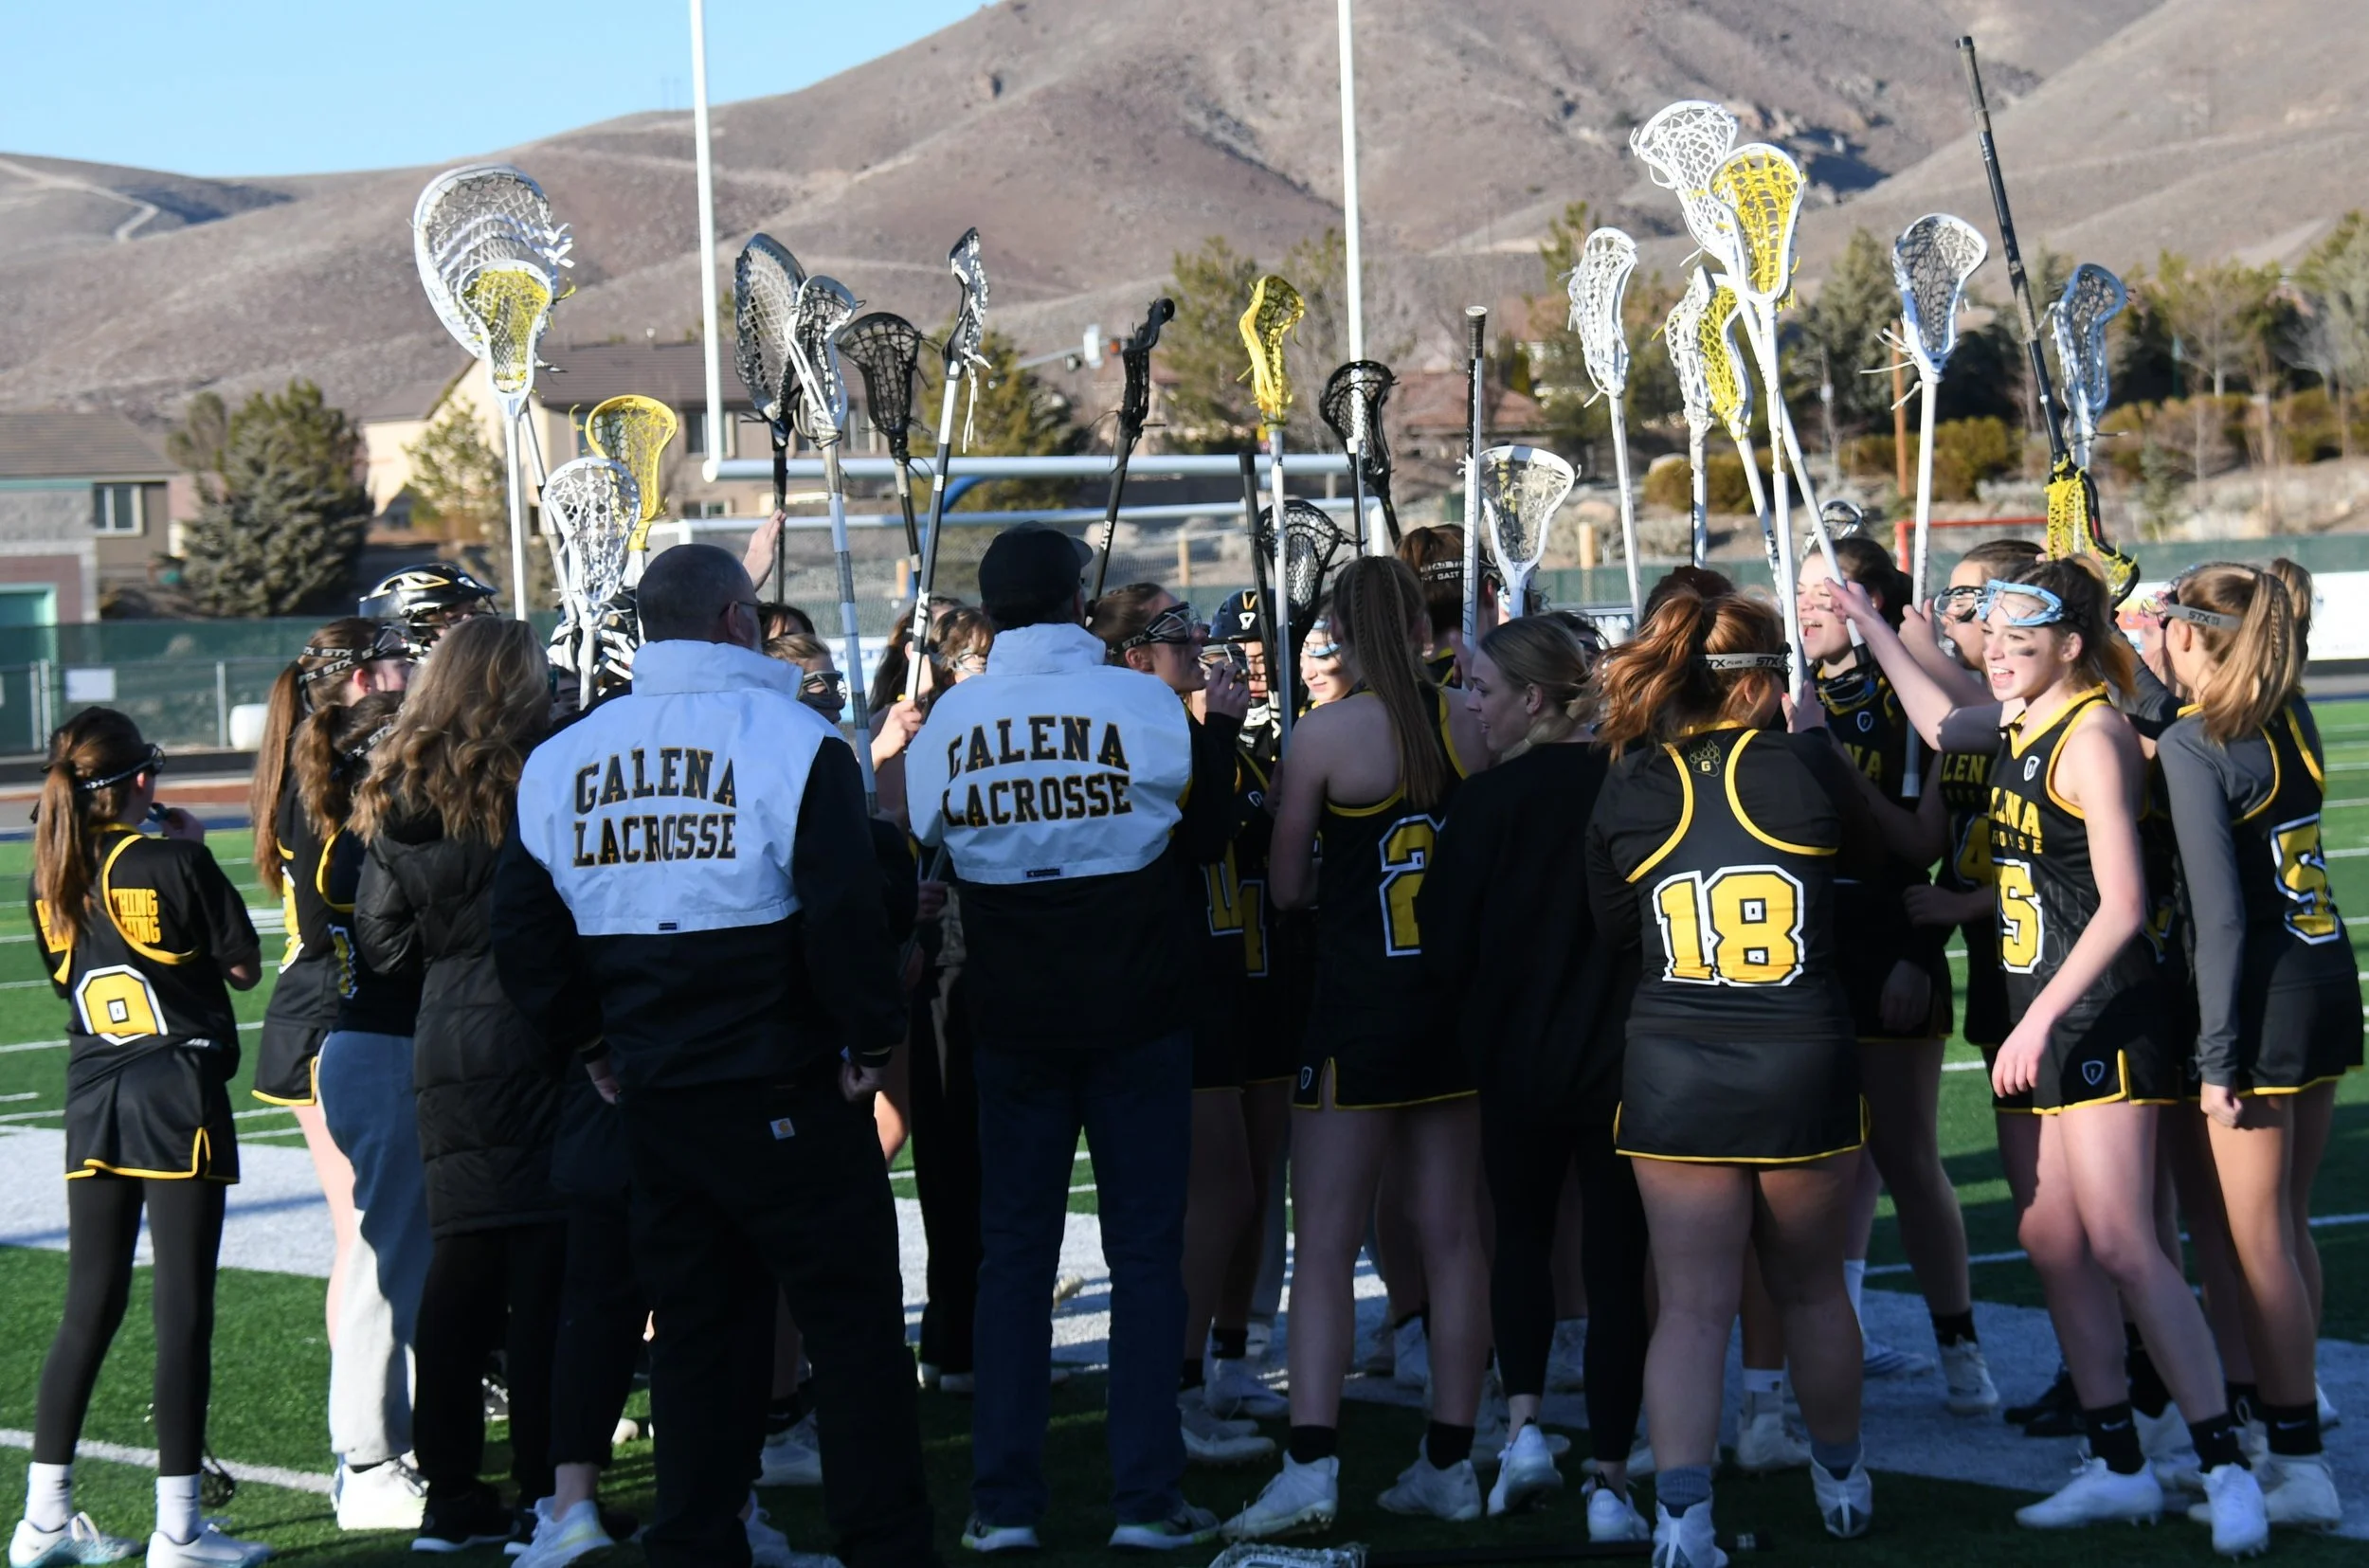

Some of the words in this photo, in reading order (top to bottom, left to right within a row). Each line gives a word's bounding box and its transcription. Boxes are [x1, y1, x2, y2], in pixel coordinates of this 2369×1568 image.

[320, 647, 354, 658] STX
[321, 657, 354, 675] STX
[948, 715, 1130, 784] GALENA
[1701, 760, 1710, 772] G
[575, 747, 737, 815] GALENA
[942, 771, 1133, 828] LACROSSE
[573, 813, 737, 868] LACROSSE
[2270, 812, 2341, 946] 5
[1653, 864, 1805, 987] 18
